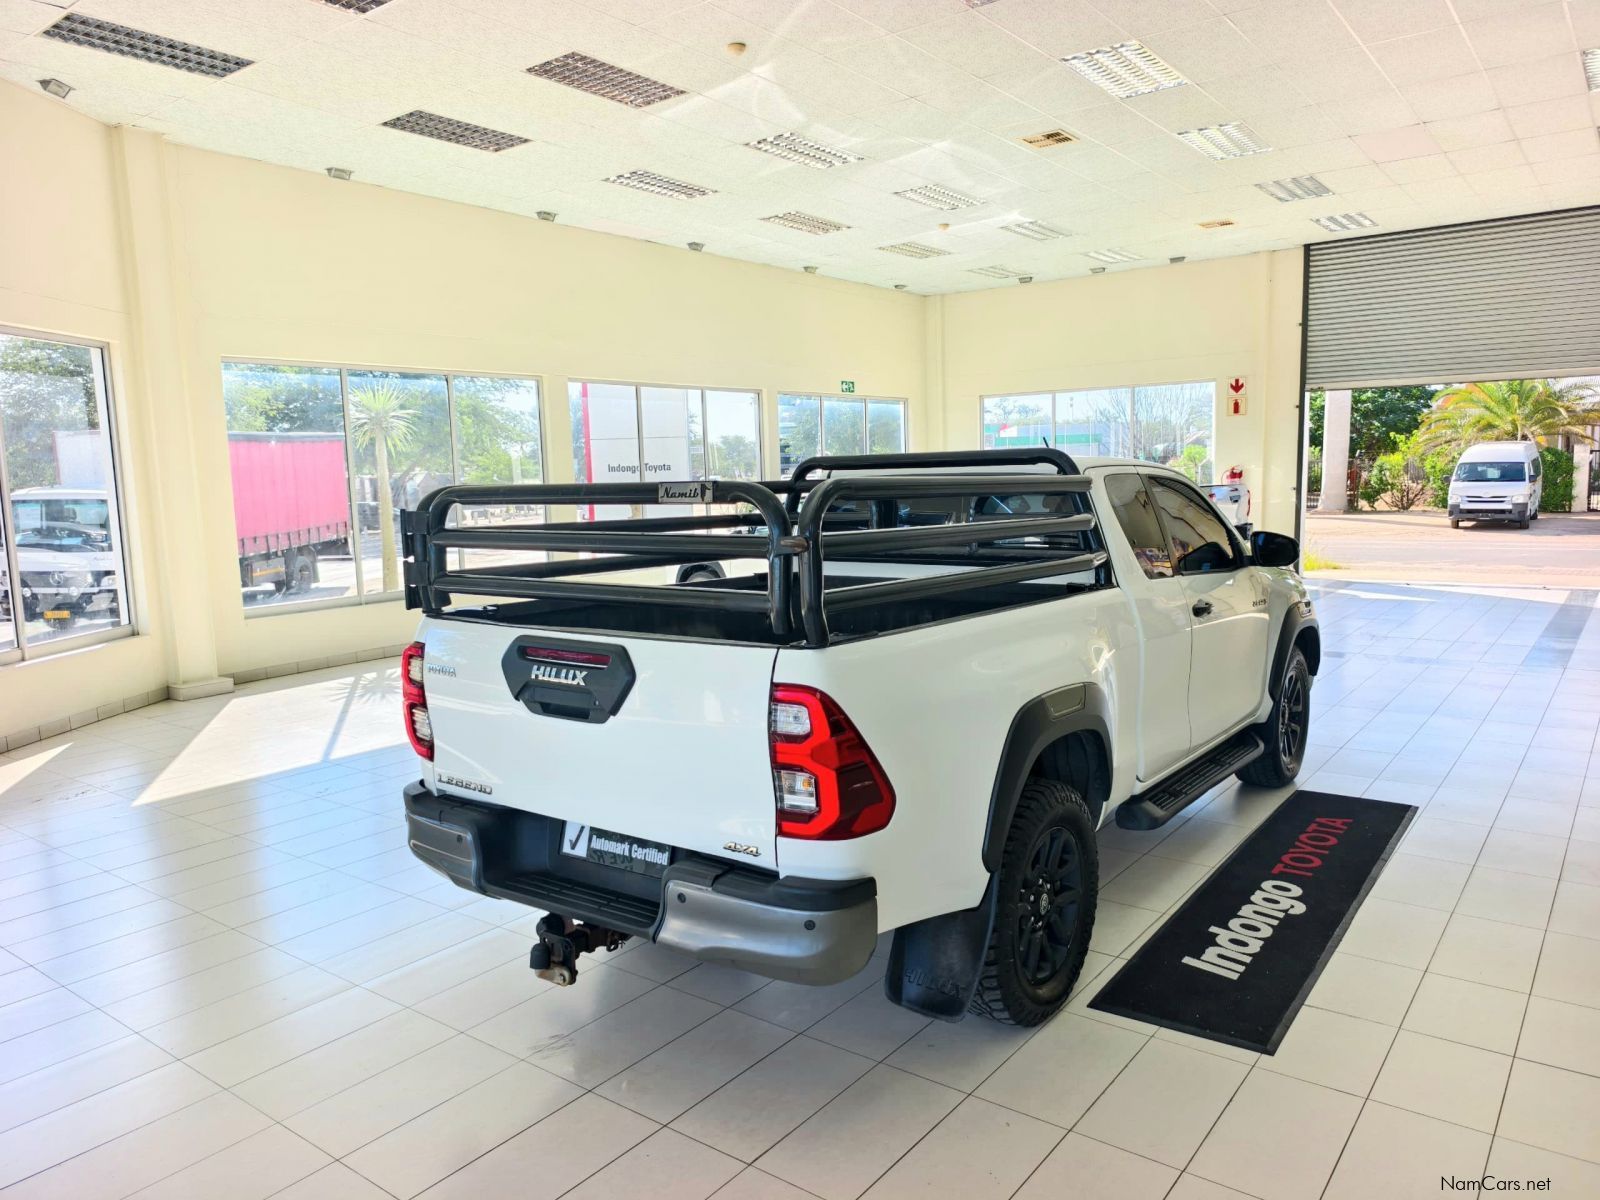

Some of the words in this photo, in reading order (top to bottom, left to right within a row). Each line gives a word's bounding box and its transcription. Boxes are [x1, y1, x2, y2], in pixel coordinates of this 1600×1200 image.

[644, 462, 671, 473] Toyota
[661, 486, 699, 499] Namib
[530, 664, 588, 686] HILUX
[437, 773, 493, 795] LEGEND
[590, 834, 630, 857] Automark
[631, 843, 669, 866] Certified
[1181, 879, 1307, 981] Indongo
[1271, 817, 1353, 877] TOYOTA
